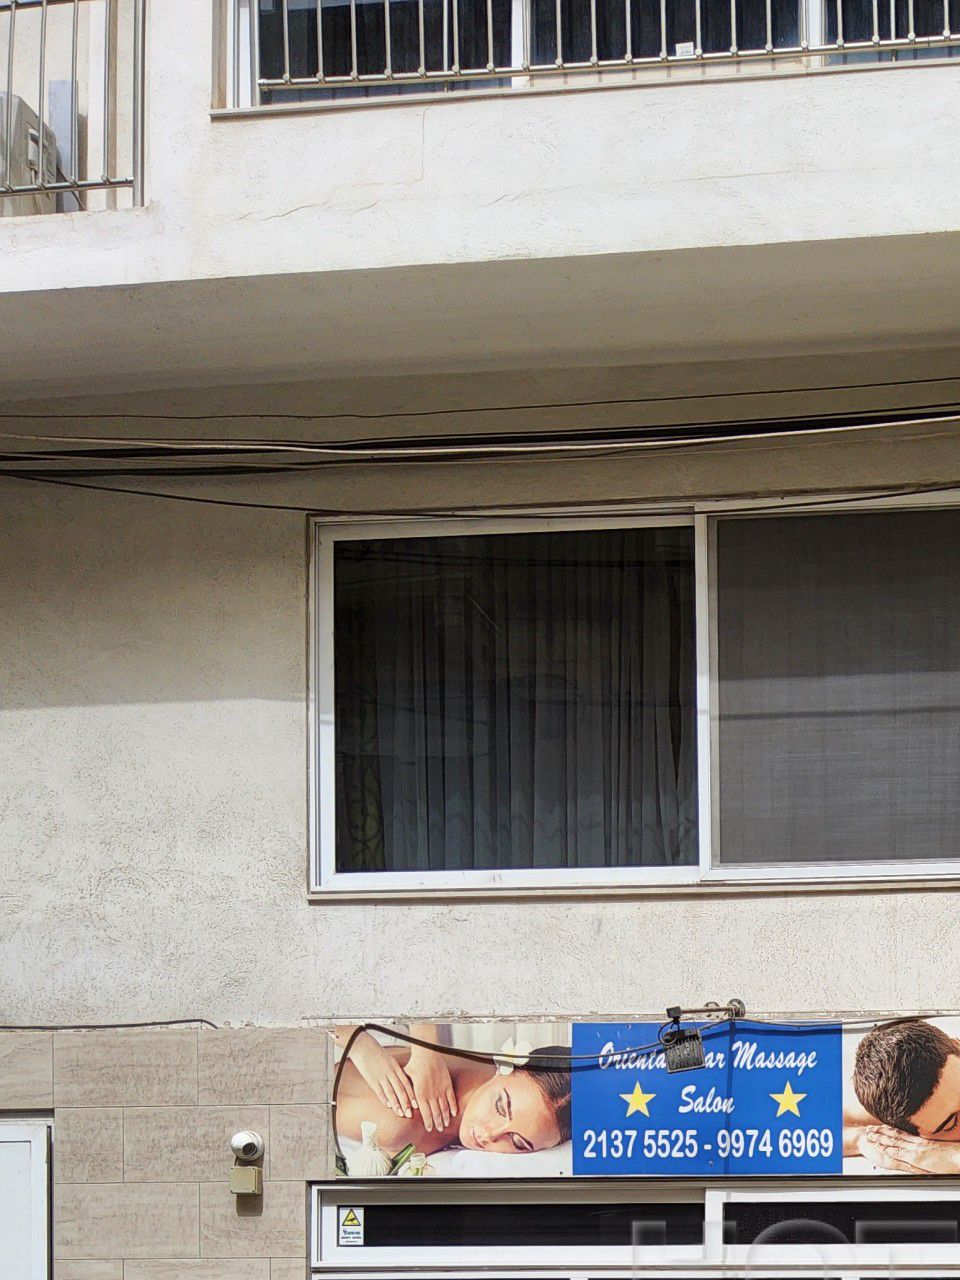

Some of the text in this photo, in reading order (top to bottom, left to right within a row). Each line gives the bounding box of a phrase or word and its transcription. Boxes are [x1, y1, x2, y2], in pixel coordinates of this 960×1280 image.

[598, 1041, 667, 1070] Orienta
[731, 1040, 818, 1075] Massage
[678, 1085, 735, 1114] Salon
[583, 1129, 637, 1158] 2137
[643, 1129, 698, 1158] 5525
[717, 1129, 773, 1158] 9974
[778, 1128, 834, 1158] 6969
